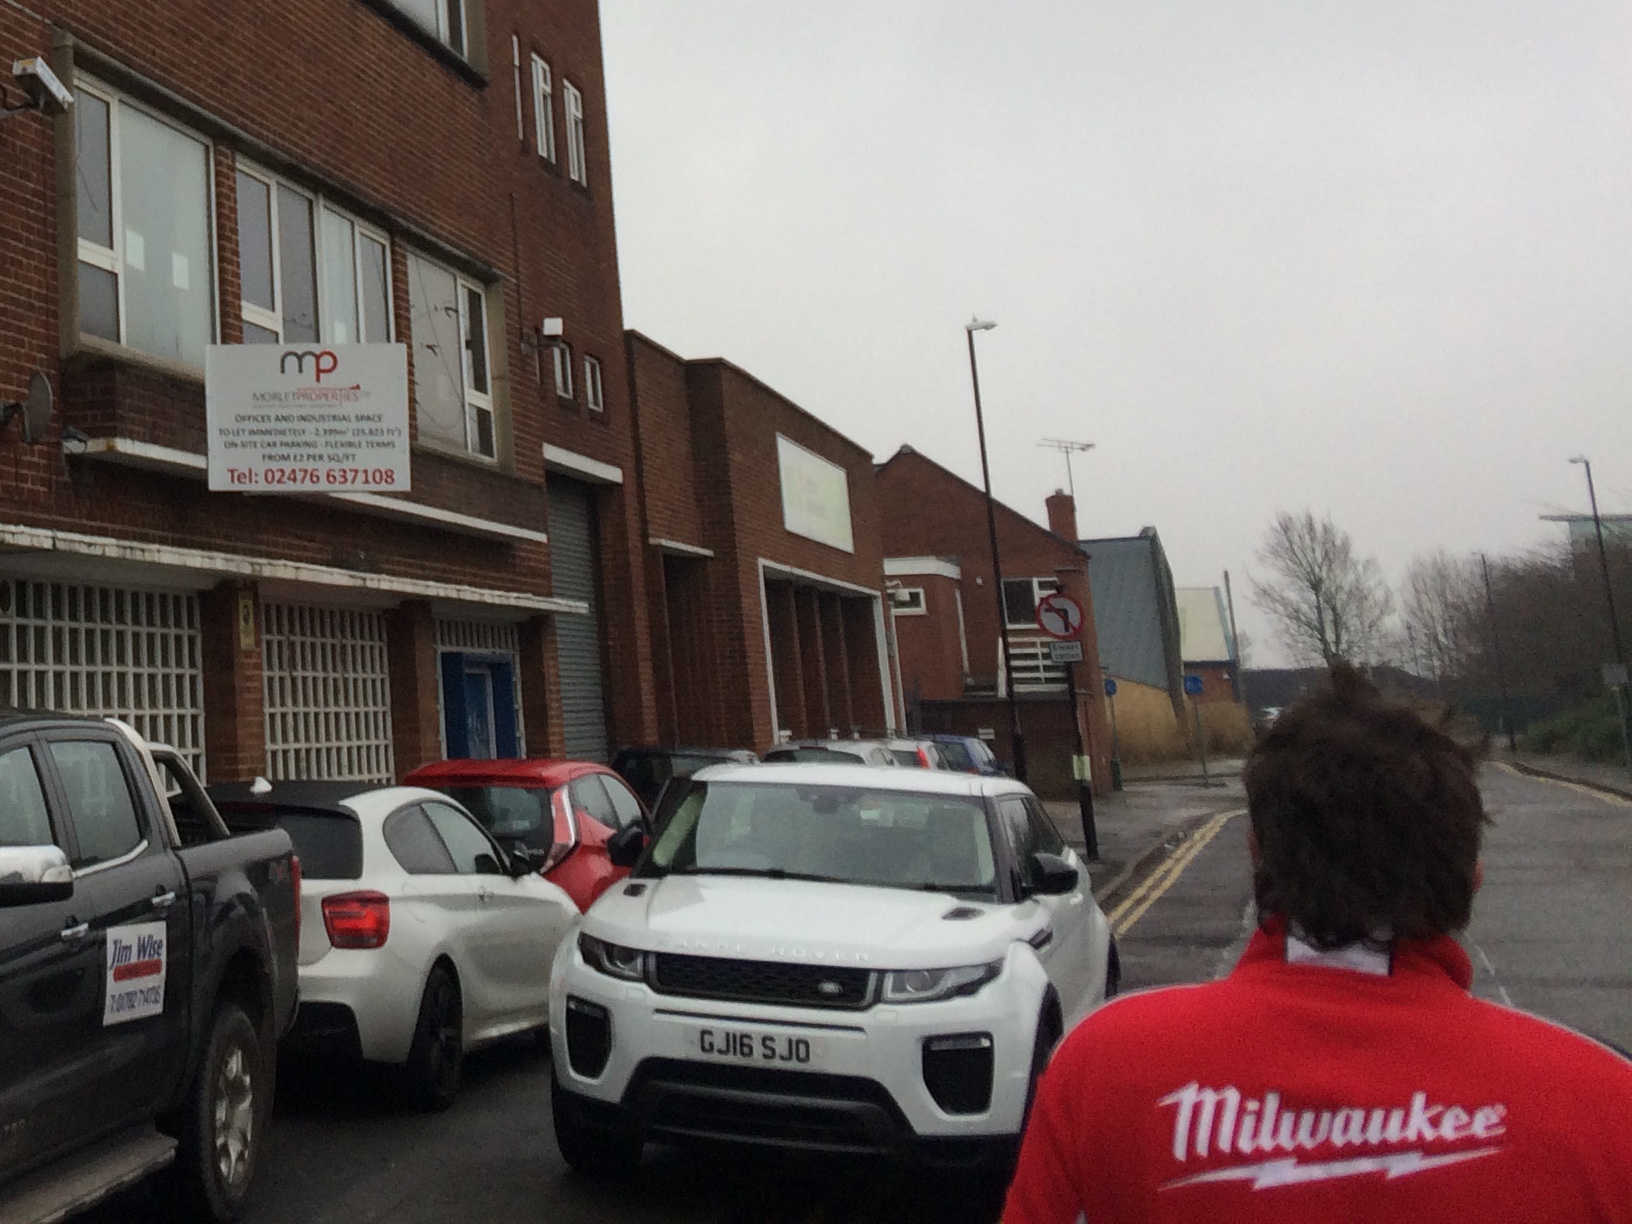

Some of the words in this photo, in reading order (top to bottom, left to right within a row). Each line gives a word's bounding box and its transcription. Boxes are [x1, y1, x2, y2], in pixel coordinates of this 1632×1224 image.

[234, 413, 271, 423] OFFICES
[274, 413, 296, 423] AND
[296, 413, 351, 423] INDUSTRIAL
[354, 413, 383, 423] SPACE
[231, 428, 245, 436] LET
[366, 440, 396, 449] TERMS
[262, 453, 291, 463] FROM
[306, 453, 324, 463] PER
[227, 468, 259, 485] Tel:
[264, 468, 320, 485] 02476
[326, 468, 395, 485] 637108
[109, 938, 132, 971] Jim
[137, 933, 163, 960] Wise
[1155, 1080, 1508, 1163] Milwaukee
